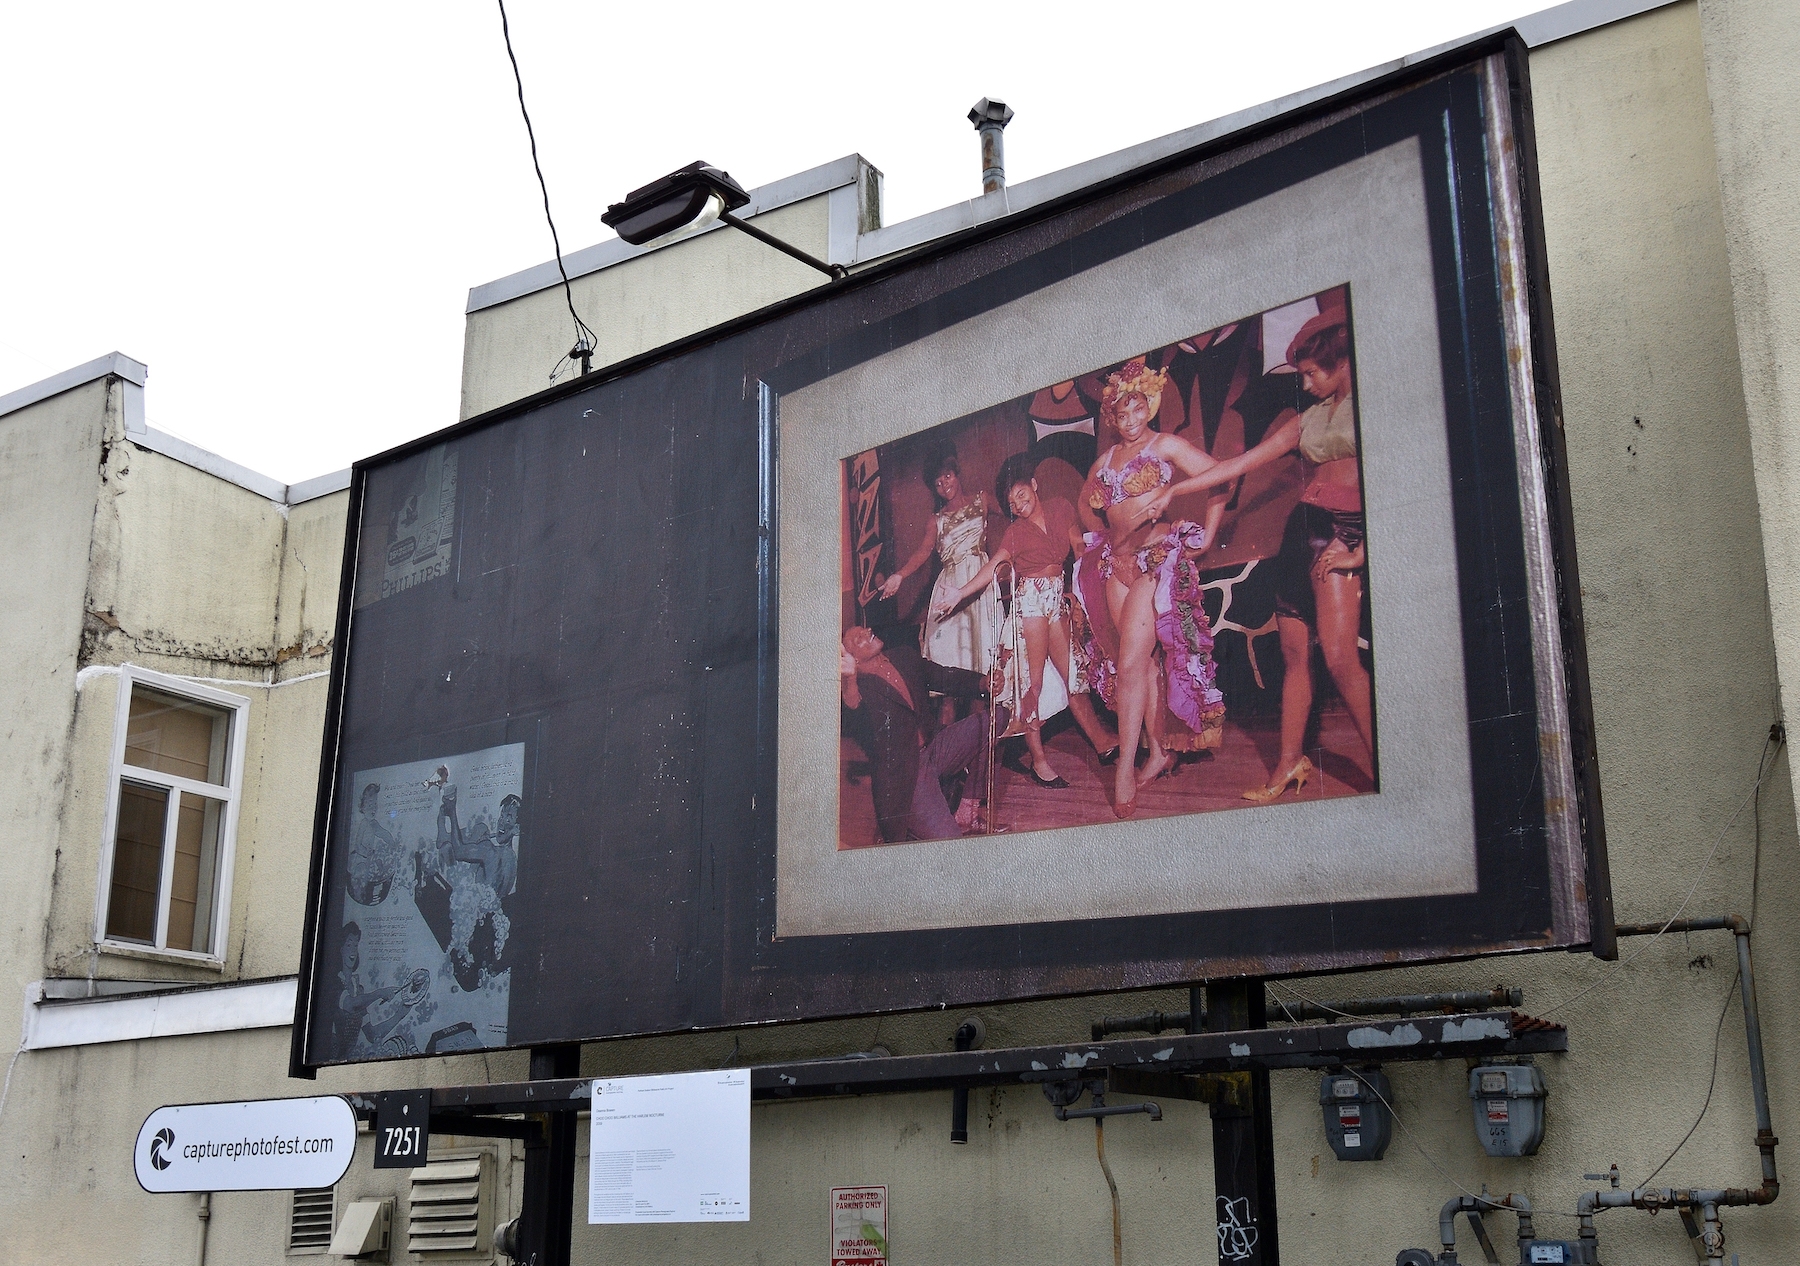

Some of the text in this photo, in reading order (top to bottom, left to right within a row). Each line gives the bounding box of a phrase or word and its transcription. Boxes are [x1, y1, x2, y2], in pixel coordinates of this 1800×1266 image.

[448, 1035, 473, 1050] SWAN
[384, 1126, 420, 1156] 7251
[183, 1135, 333, 1162] capturephotofest.com
[839, 1192, 879, 1200] AUTHORIZED
[836, 1201, 881, 1210] PARKING ONLY
[840, 1239, 877, 1247] VIOLATORS
[837, 1248, 860, 1256] TOWED
